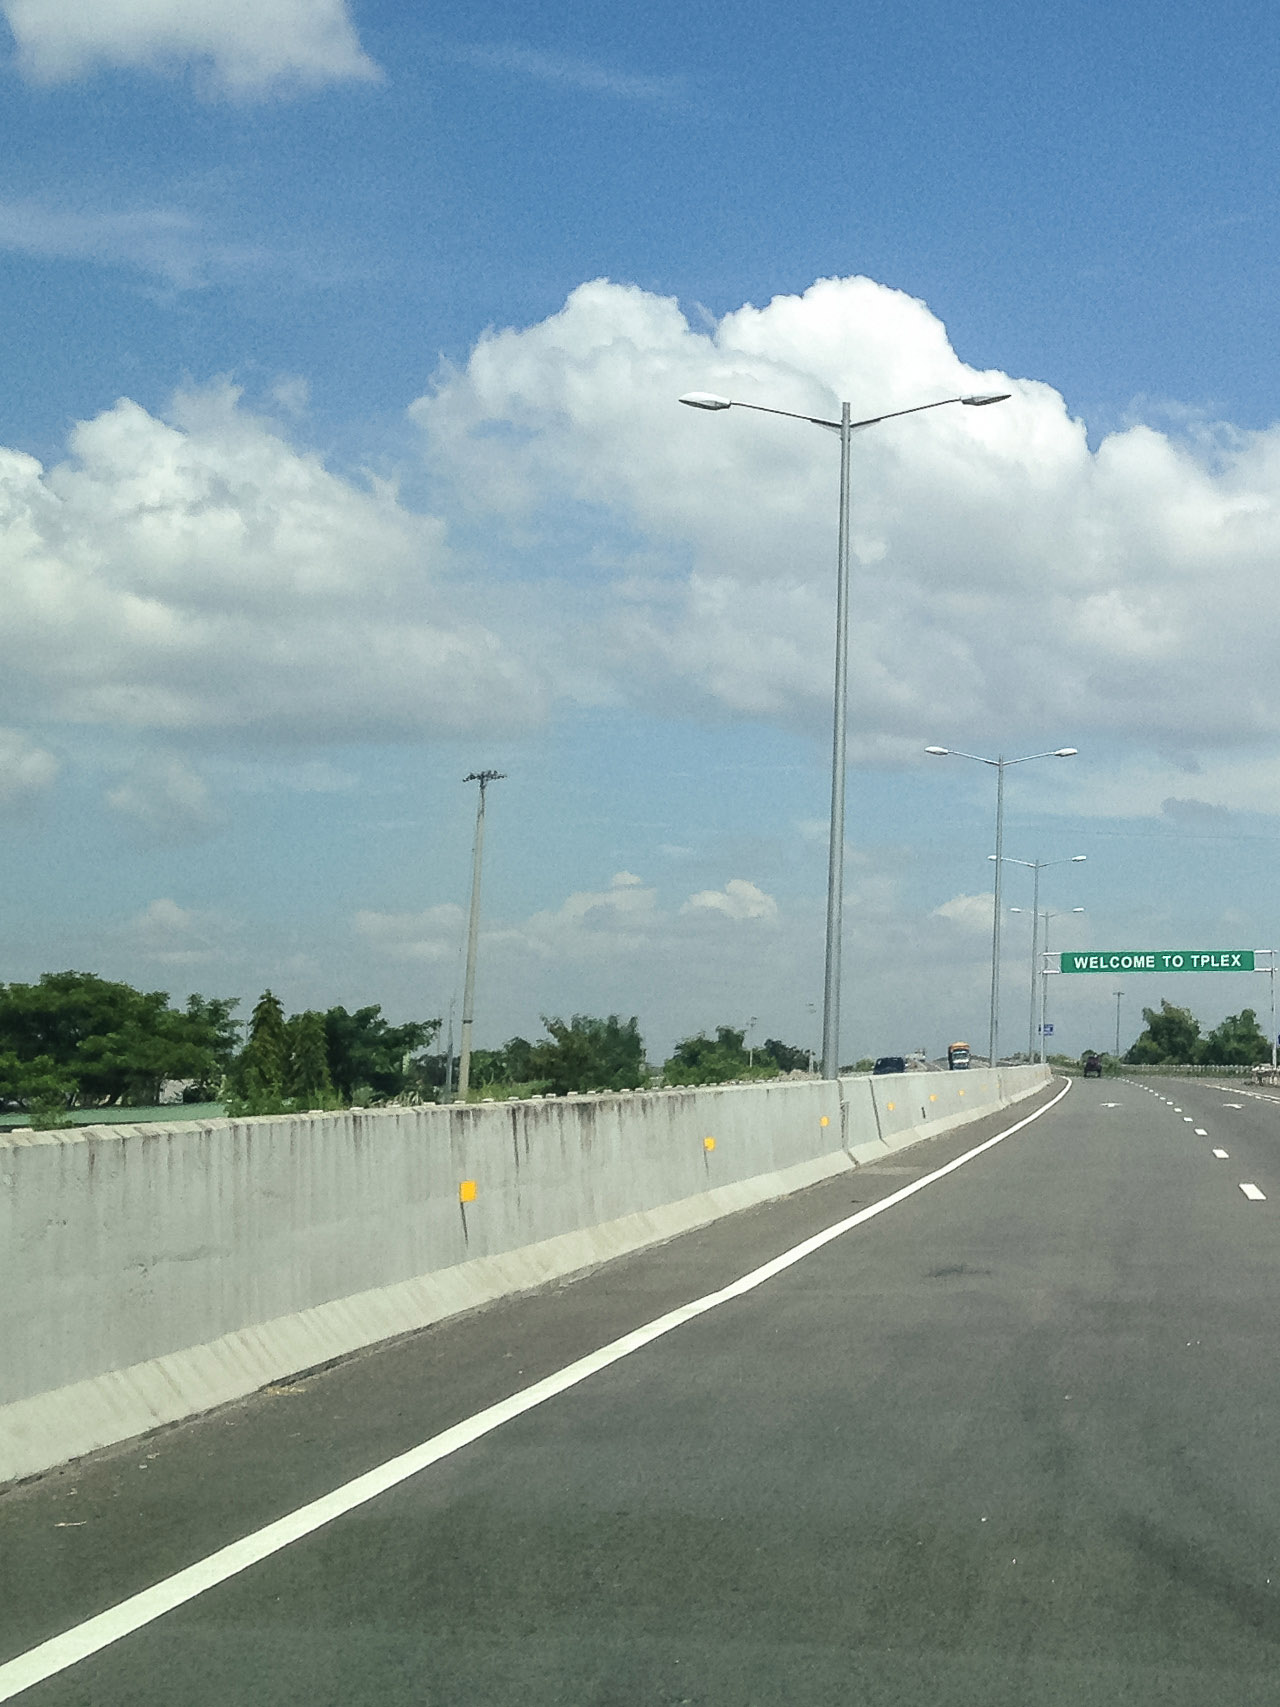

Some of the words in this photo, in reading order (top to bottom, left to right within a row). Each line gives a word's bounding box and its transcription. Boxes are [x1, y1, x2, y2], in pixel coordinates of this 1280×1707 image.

[1074, 955, 1155, 969] WELCOME
[1162, 955, 1184, 968] TO
[1191, 954, 1241, 968] TPLEX
